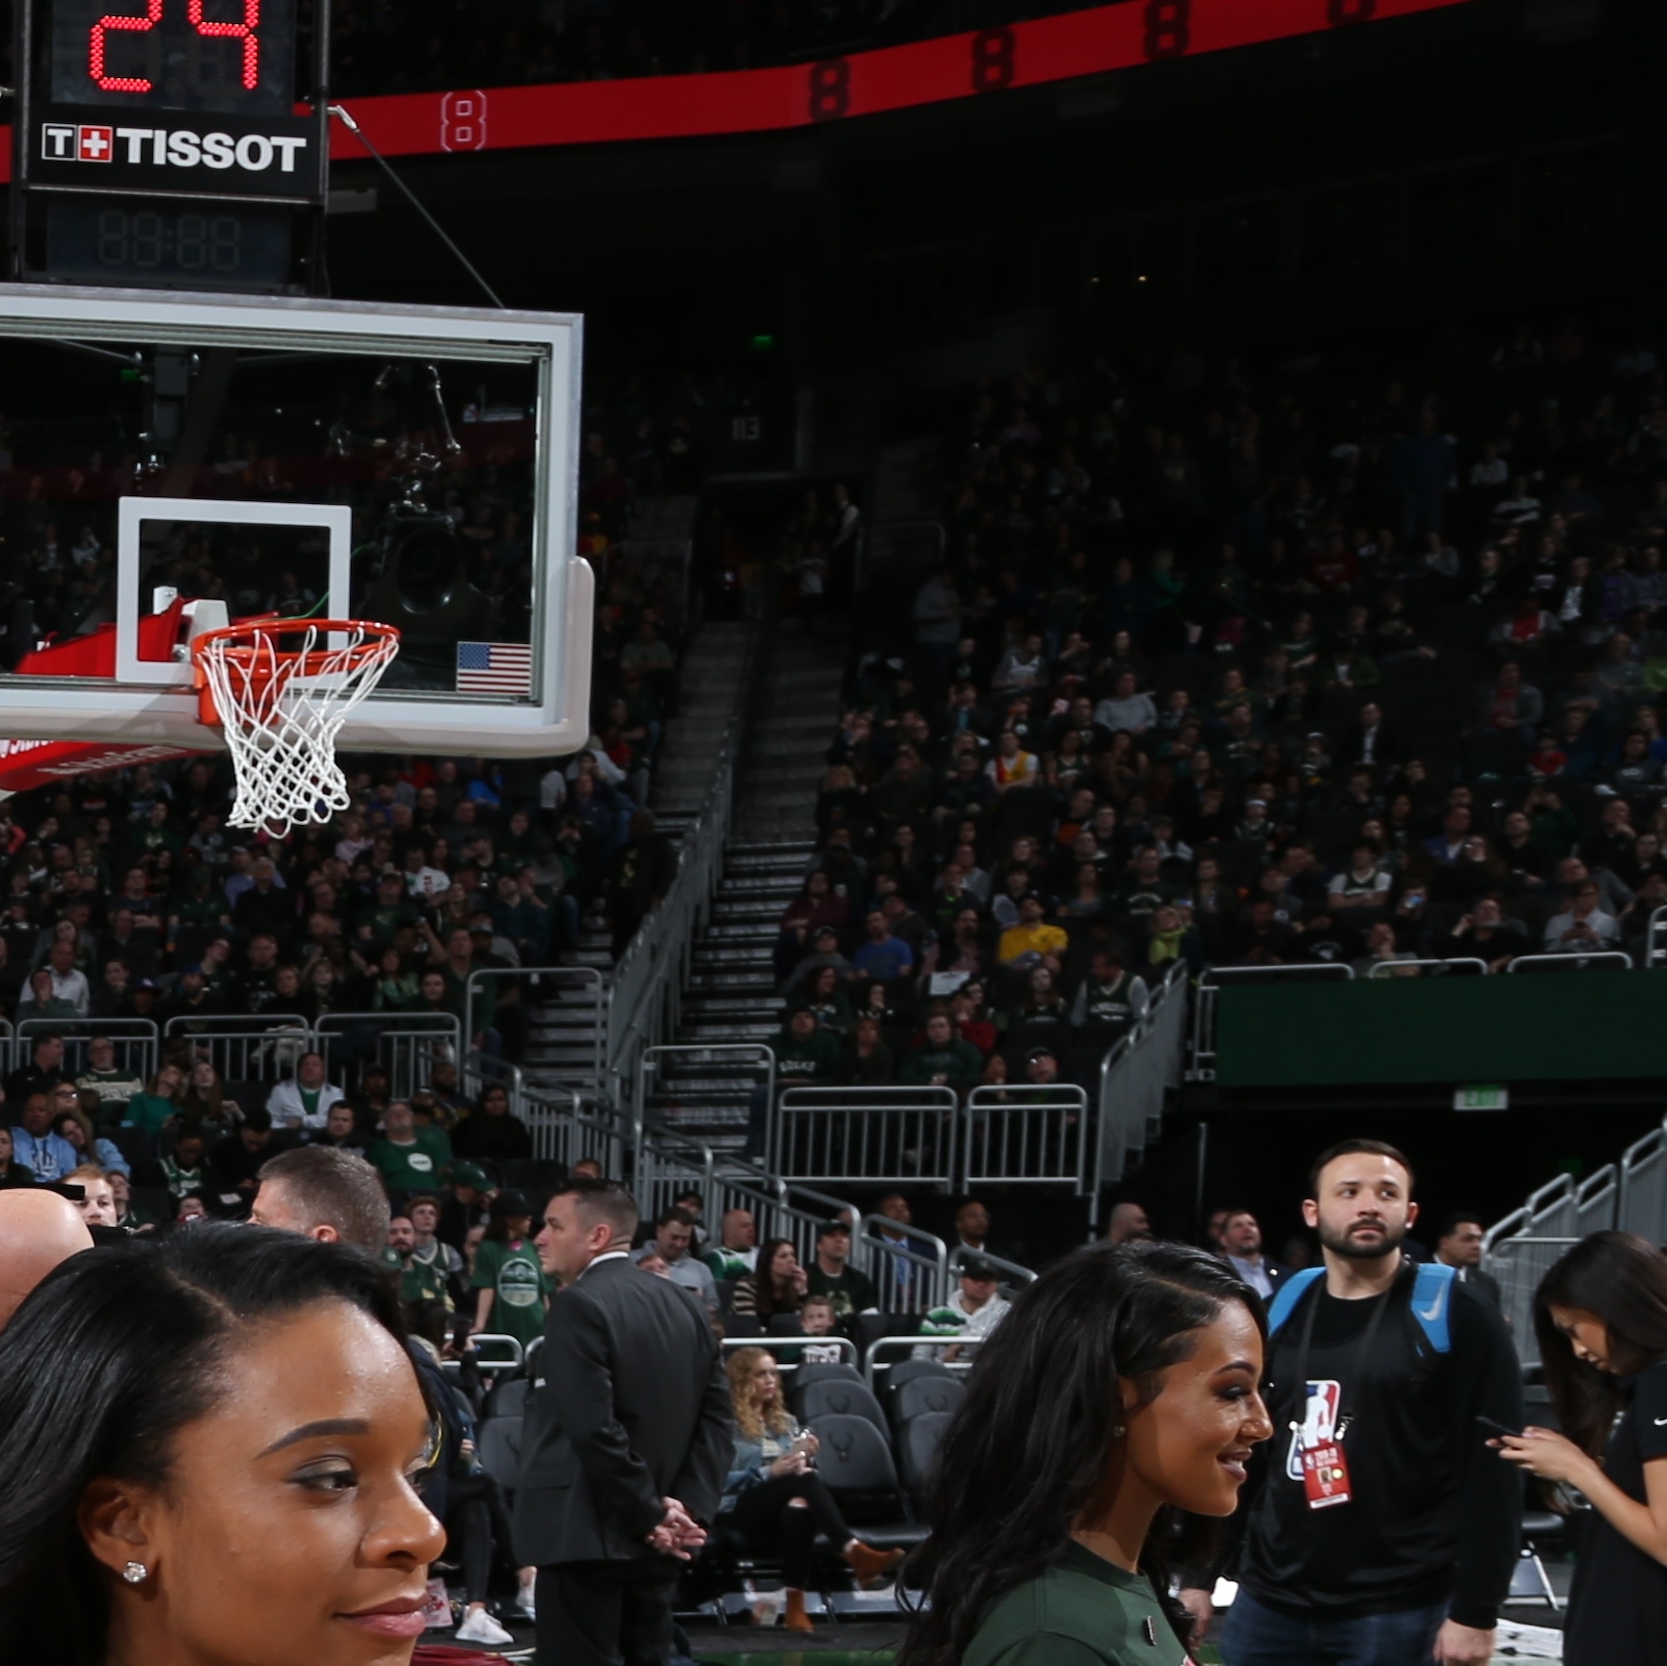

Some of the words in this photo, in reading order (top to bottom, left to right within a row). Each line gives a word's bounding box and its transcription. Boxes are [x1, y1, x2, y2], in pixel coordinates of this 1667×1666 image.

[88, 0, 260, 93] 24
[116, 127, 307, 173] TISSOT
[440, 89, 487, 152] 8
